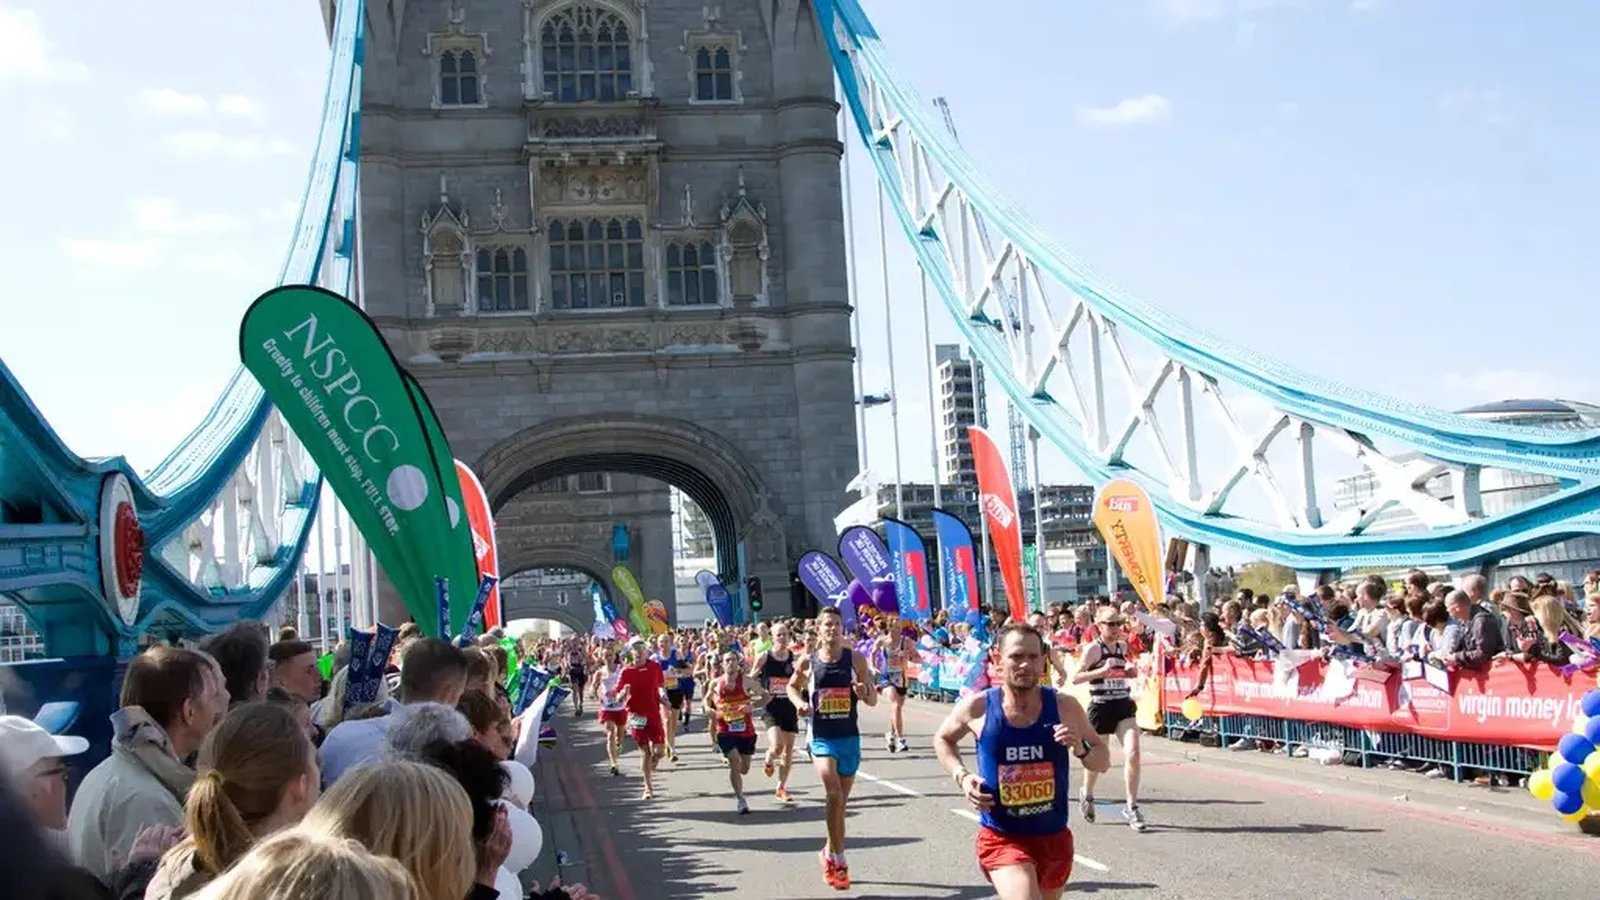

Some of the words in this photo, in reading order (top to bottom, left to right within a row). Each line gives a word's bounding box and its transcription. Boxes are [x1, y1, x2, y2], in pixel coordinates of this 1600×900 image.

[283, 312, 400, 463] NSPCC
[262, 338, 294, 377] Cruelty
[290, 374, 303, 388] to
[299, 387, 331, 429] children
[326, 428, 351, 456] must
[361, 479, 382, 508] FULL
[1459, 688, 1501, 723] virgin
[1505, 697, 1564, 728] money
[1006, 746, 1043, 761] BEN
[1002, 782, 1053, 802] 33060
